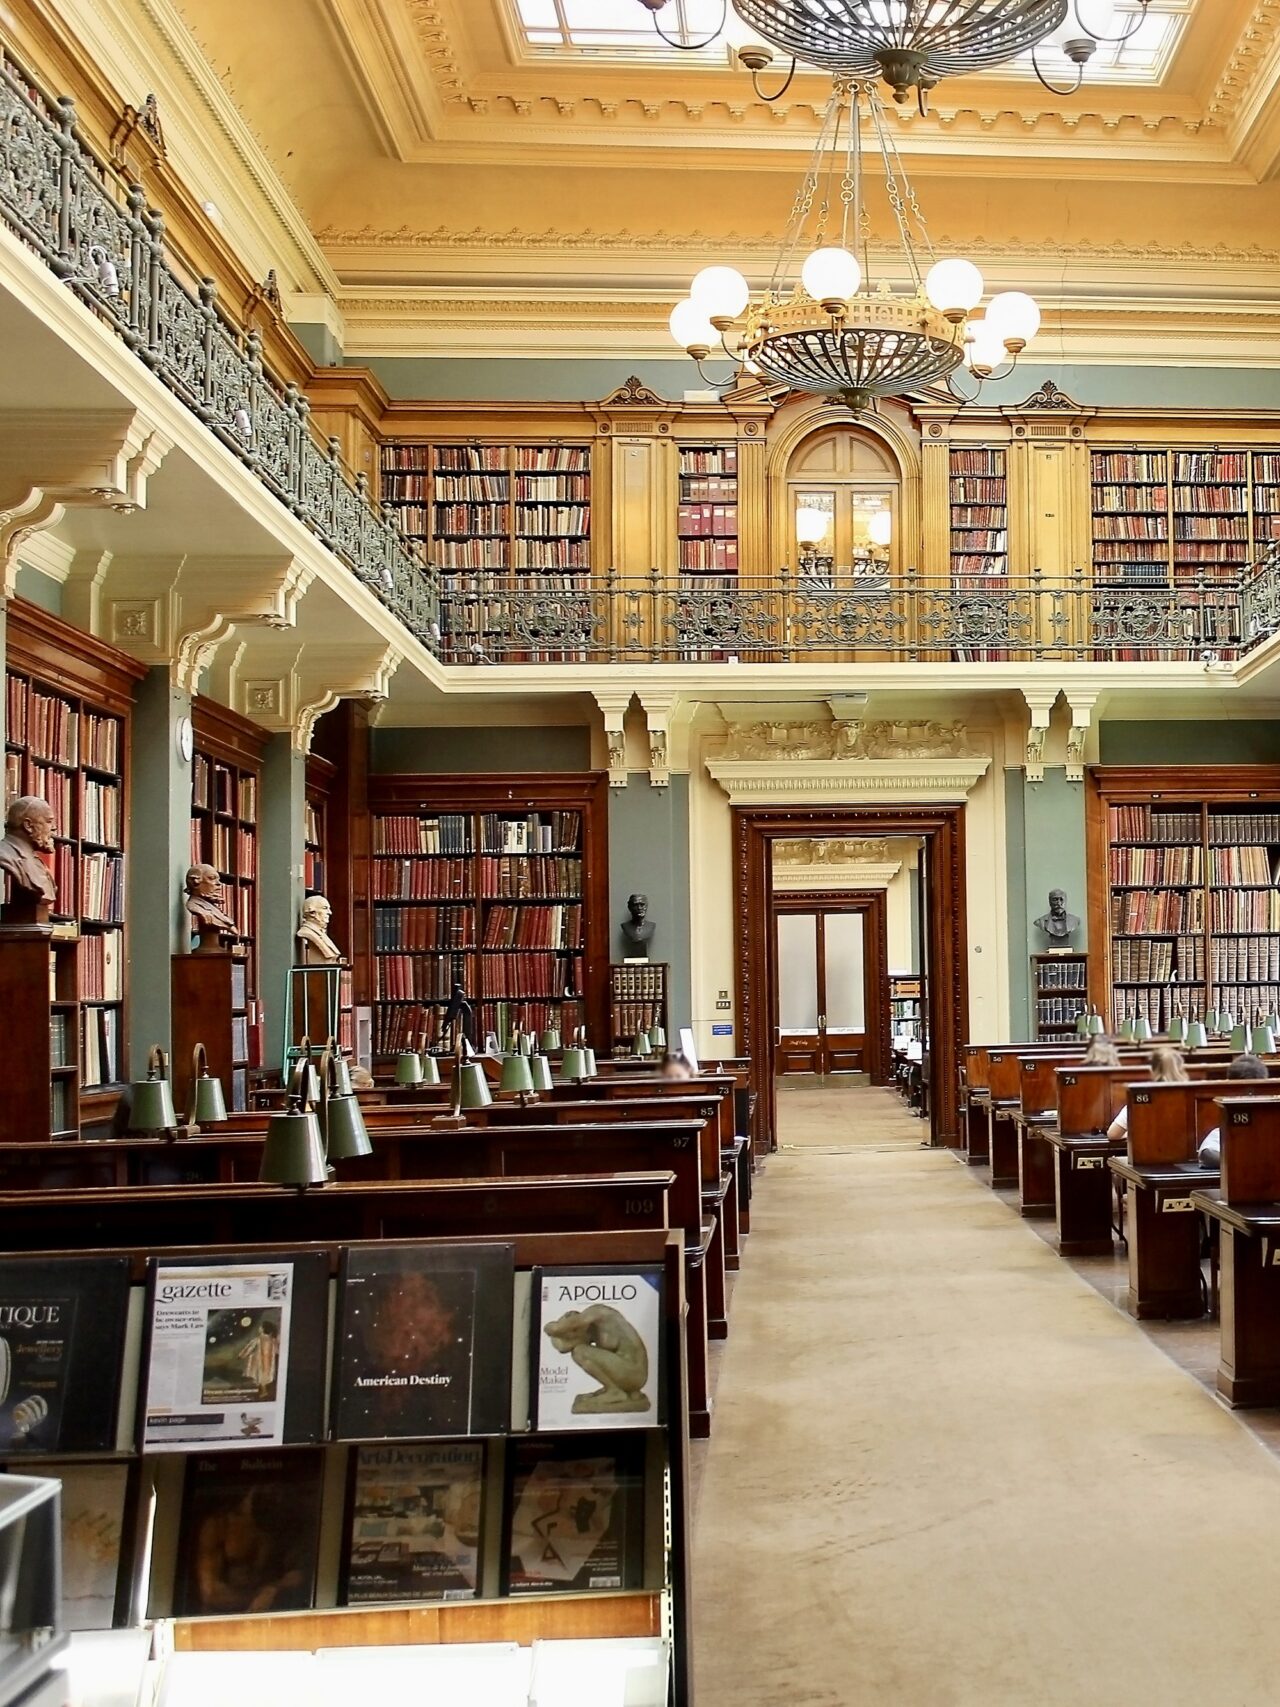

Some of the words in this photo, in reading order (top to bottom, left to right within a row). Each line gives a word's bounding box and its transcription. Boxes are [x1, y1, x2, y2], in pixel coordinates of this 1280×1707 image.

[718, 1087, 730, 1095] 73
[260, 1099, 270, 1107] 71
[1136, 1094, 1149, 1102] 86
[700, 1107, 714, 1116] 85
[1233, 1113, 1249, 1123] 98
[673, 1137, 690, 1148] 97
[625, 1199, 653, 1214] 109
[155, 1282, 232, 1304] gazette
[559, 1284, 637, 1301] APOLLO
[540, 1366, 568, 1376] Model
[354, 1375, 408, 1387] American
[410, 1373, 452, 1387] Destiny
[540, 1375, 568, 1385] Maker
